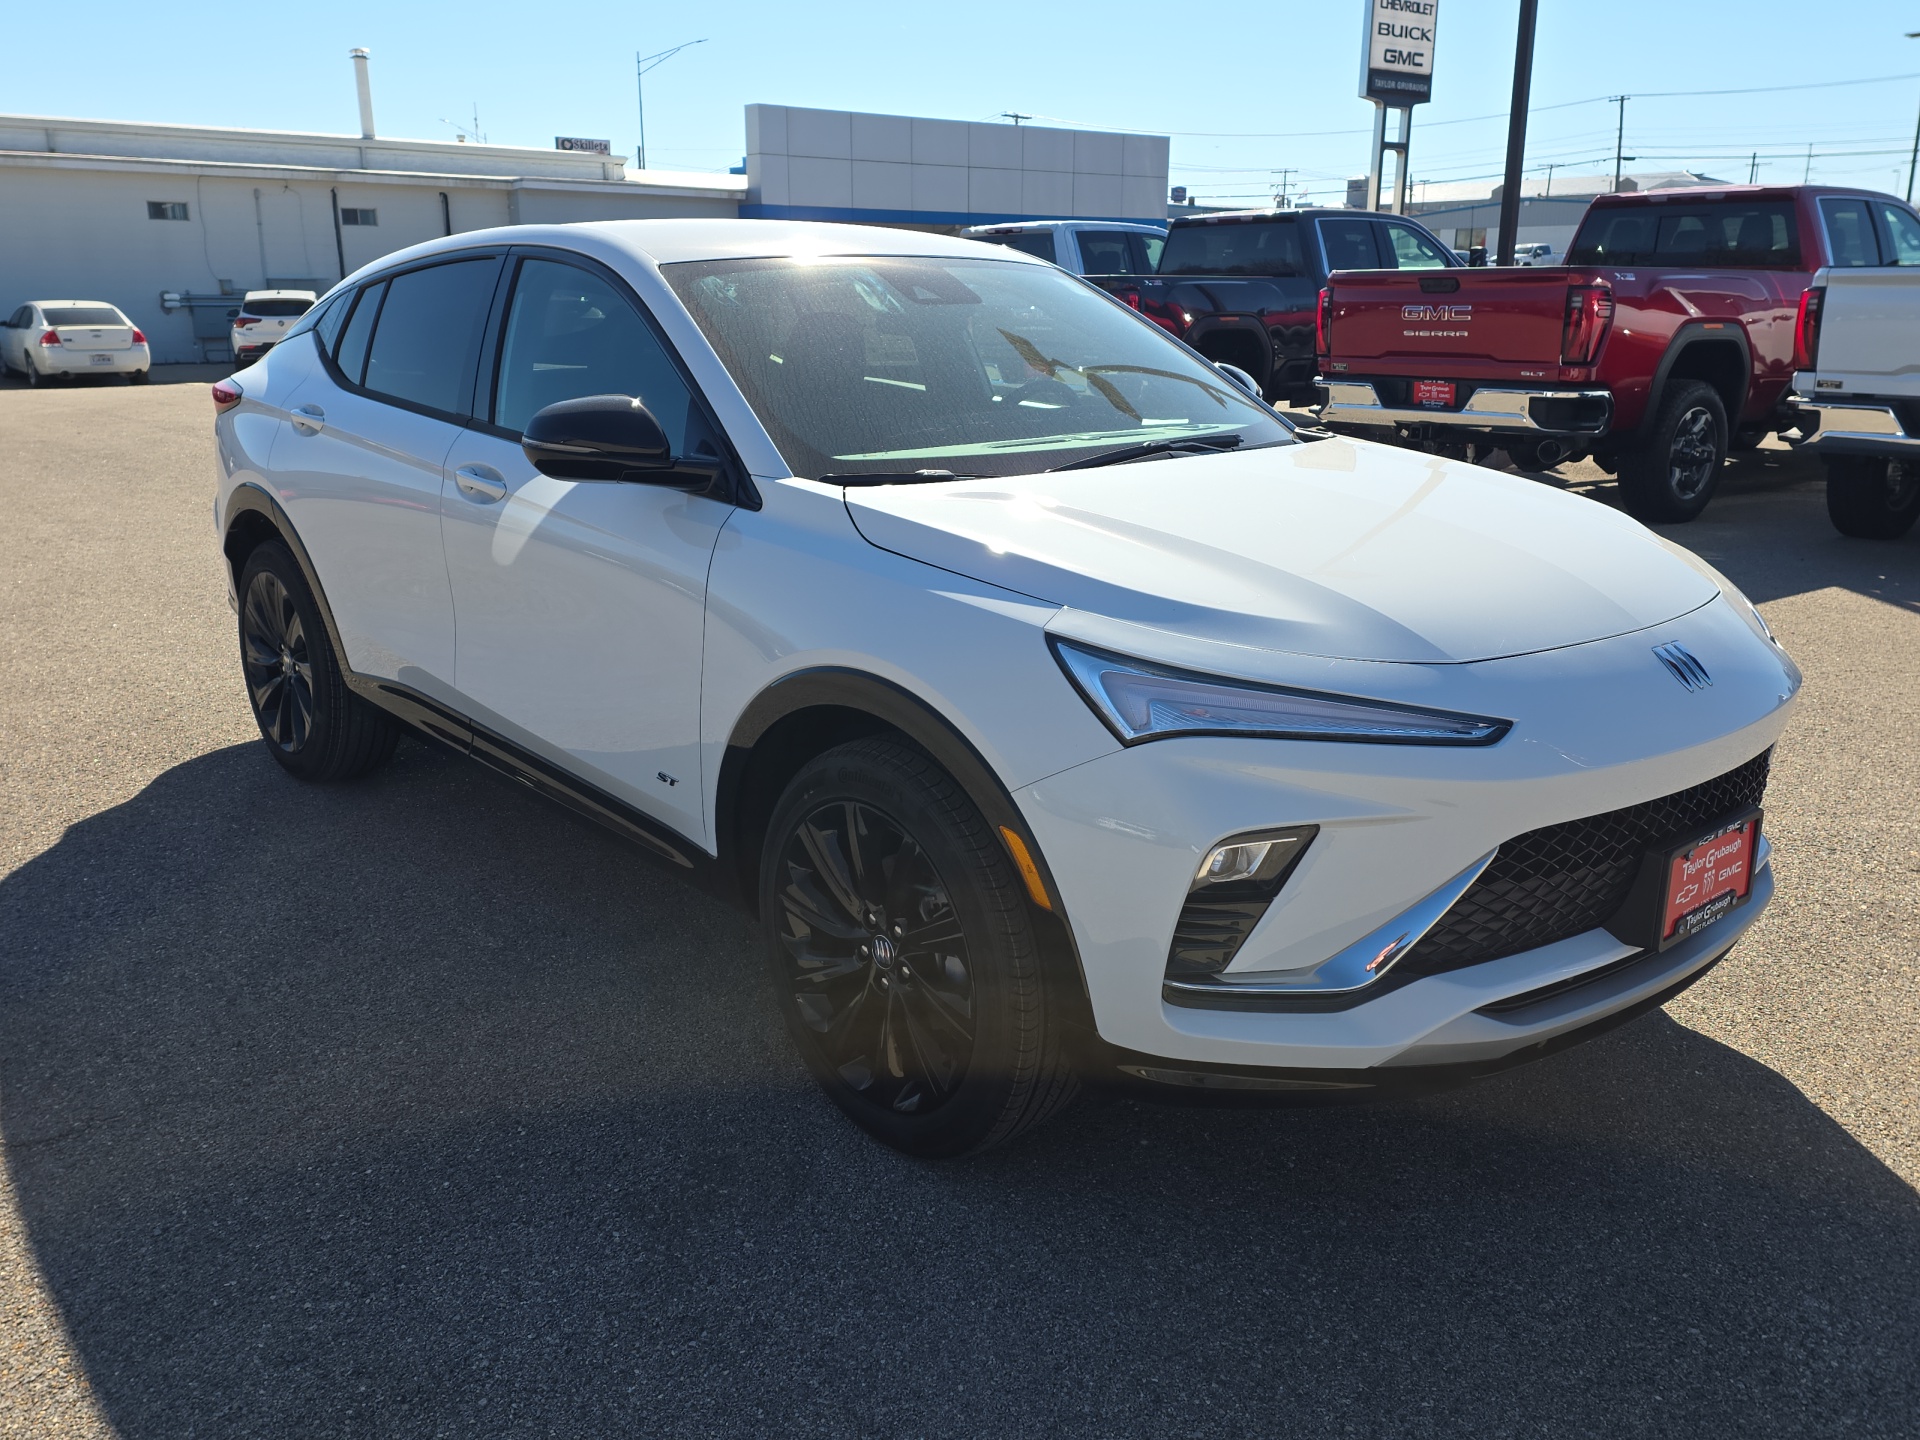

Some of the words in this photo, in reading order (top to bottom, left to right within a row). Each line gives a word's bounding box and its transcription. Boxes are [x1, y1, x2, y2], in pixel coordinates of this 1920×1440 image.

[1380, 0, 1434, 16] CHEVROLET
[1378, 22, 1431, 42] BUICK
[1384, 49, 1423, 67] GMC
[1375, 79, 1395, 90] TAYLOR
[1396, 81, 1428, 92] GRUBAUGH
[574, 140, 608, 151] Skillets
[1402, 305, 1471, 320] GMC
[1403, 329, 1469, 337] SIERRA
[656, 771, 680, 787] ST
[1726, 820, 1742, 833] GMC
[1682, 857, 1706, 882] Taylor
[1705, 838, 1742, 869] Grubaugh
[1718, 860, 1743, 882] GMC
[1686, 911, 1704, 930] Taylor
[1703, 895, 1731, 919] Grubaugh
[1690, 923, 1702, 935] WEST
